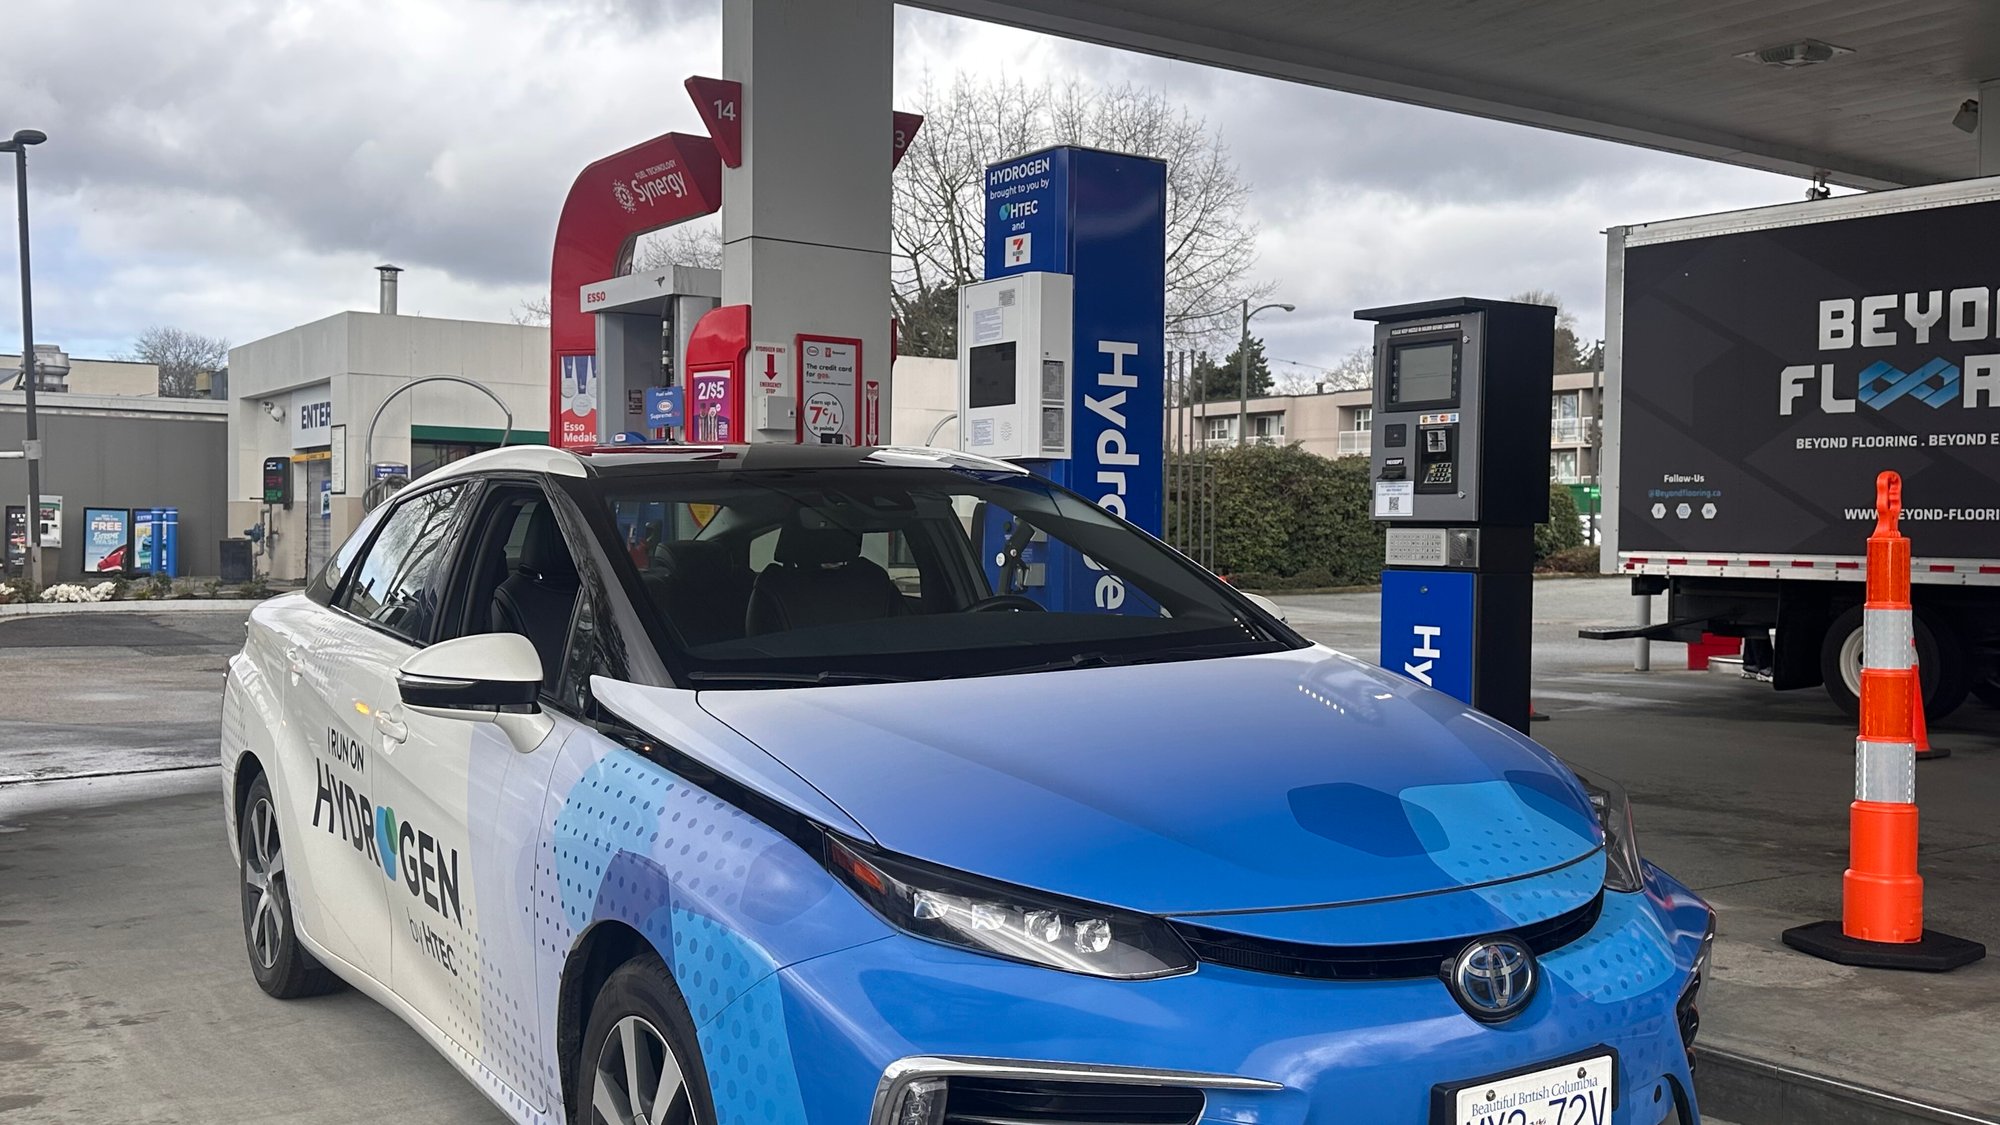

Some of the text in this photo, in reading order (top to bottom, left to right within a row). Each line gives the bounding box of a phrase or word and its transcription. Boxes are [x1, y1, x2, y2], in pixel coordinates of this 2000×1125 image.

[714, 100, 736, 121] 14
[635, 160, 676, 179] FUEL TECHNOLOGY
[990, 157, 1050, 186] HYDROGEN
[631, 171, 688, 207] Synergy
[990, 178, 1050, 200] brought to you by
[1010, 200, 1038, 219] HTEC
[1012, 220, 1025, 231] and
[587, 291, 606, 303] ESSO
[1819, 286, 2000, 350] BEYO
[756, 345, 775, 353] HYDROGEN
[698, 381, 725, 400] 2/$5
[563, 421, 585, 432] Esso
[563, 432, 597, 442] Medals
[1796, 437, 1847, 449] BEYOND
[1852, 435, 1918, 448] FLOORING
[1929, 433, 1987, 446] BEYOND
[1663, 474, 1705, 483] Follow-Us
[91, 521, 122, 531] FREE
[327, 726, 364, 774] I RUN ON
[406, 906, 458, 977] by HTEC
[1471, 1093, 1516, 1117] Beautiful
[1518, 1086, 1550, 1105] British
[1551, 1076, 1598, 1097] Columbia
